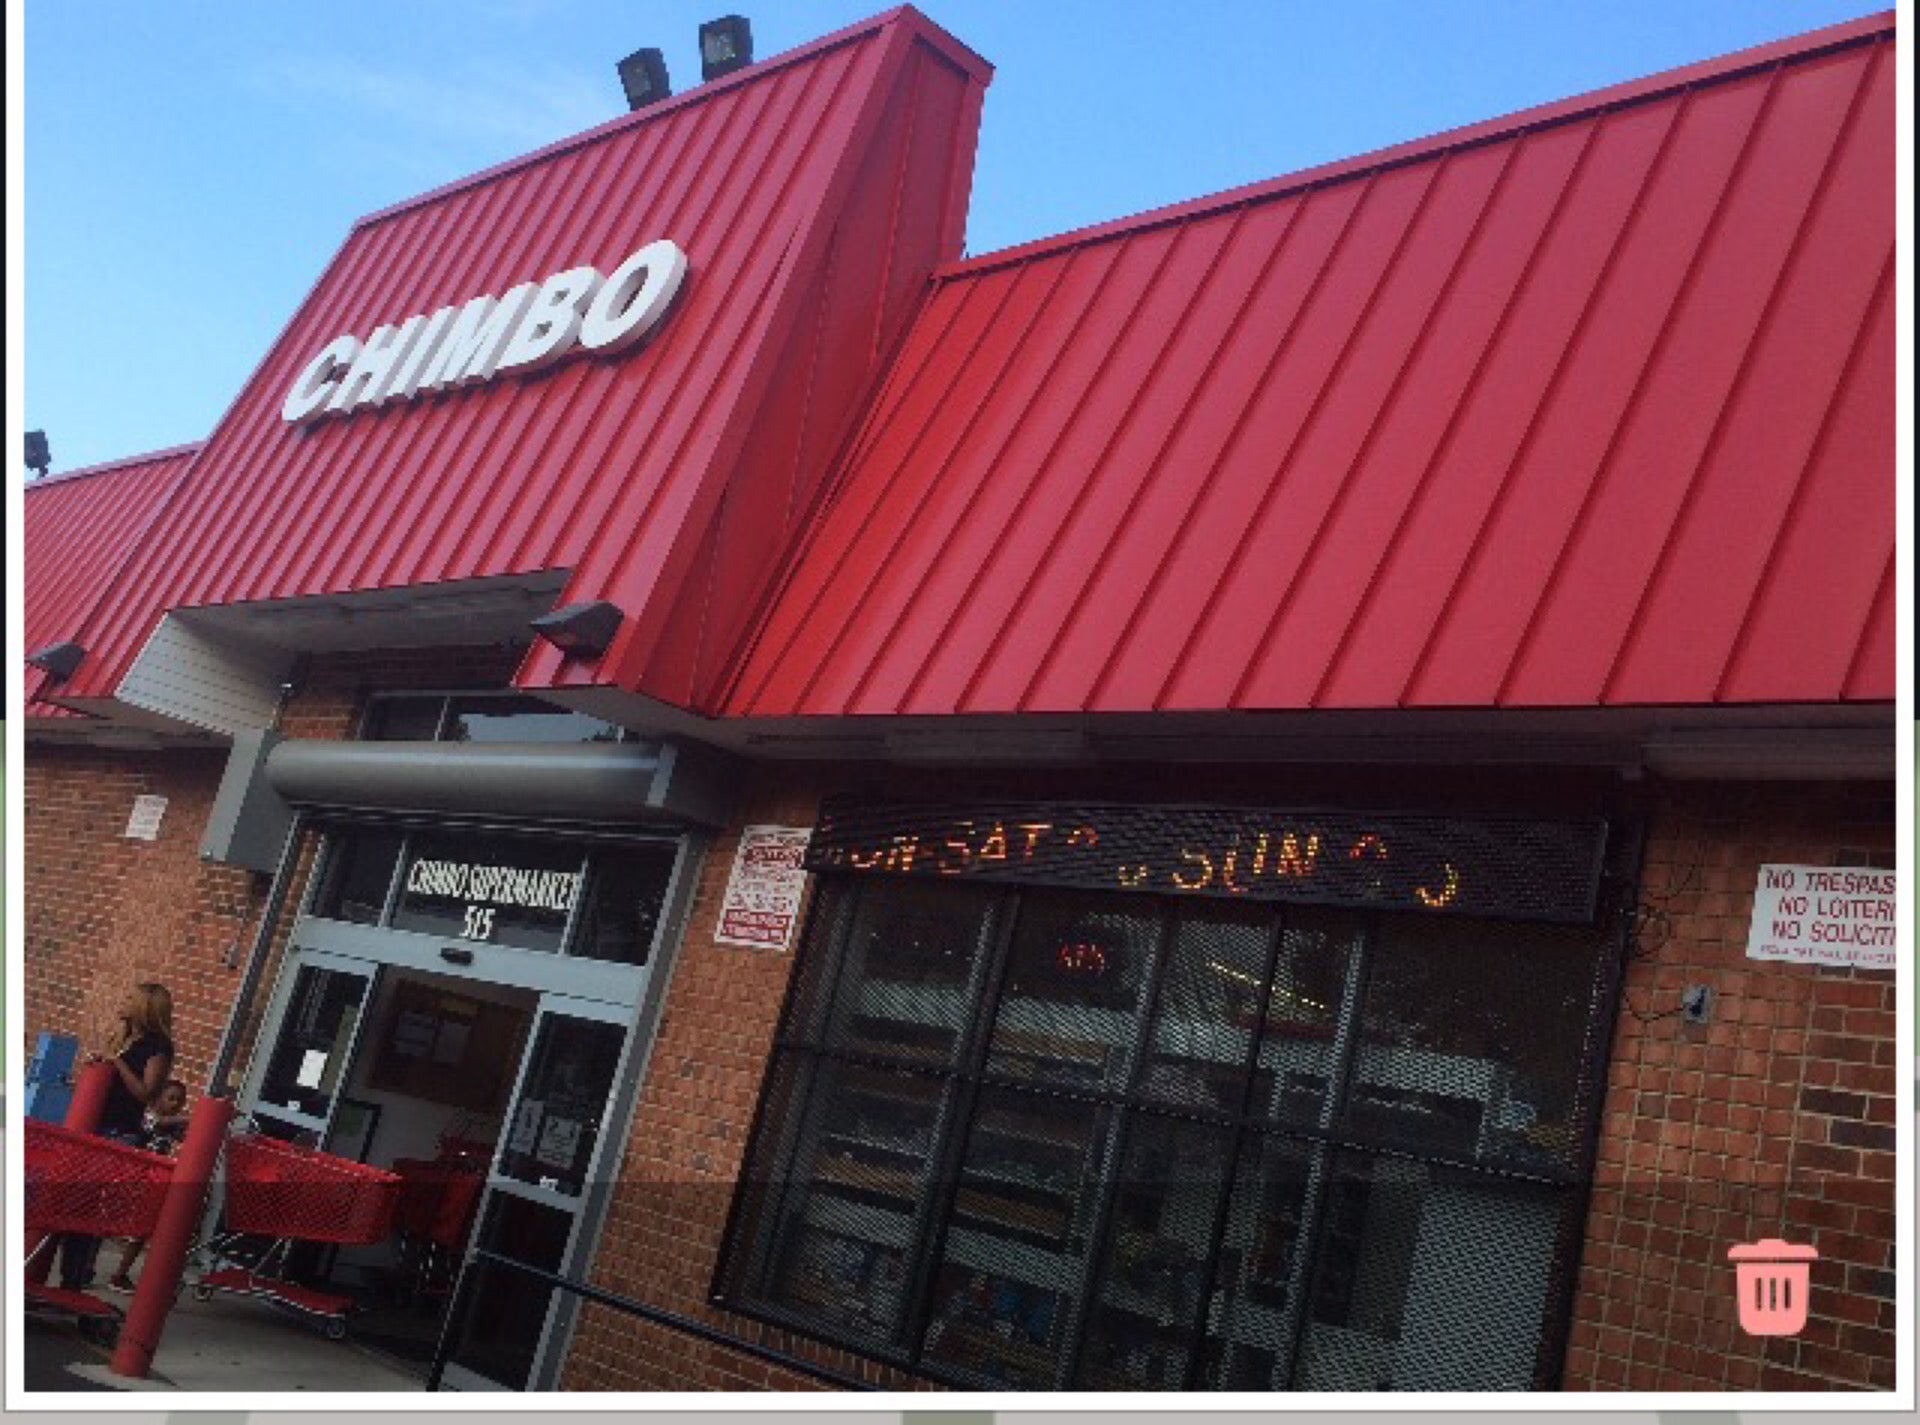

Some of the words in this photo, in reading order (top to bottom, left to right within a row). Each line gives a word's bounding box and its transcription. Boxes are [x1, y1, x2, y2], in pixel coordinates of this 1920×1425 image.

[282, 239, 688, 421] CHIMBO
[1172, 833, 1319, 894] SUN
[407, 858, 469, 898] CHIMBO
[465, 864, 580, 911] SUPERMARKET
[1766, 870, 1795, 891] NO
[1805, 872, 1896, 894] TRESPAS
[459, 905, 496, 940] 515
[1778, 896, 1809, 916] NO
[1772, 921, 1801, 940] NO
